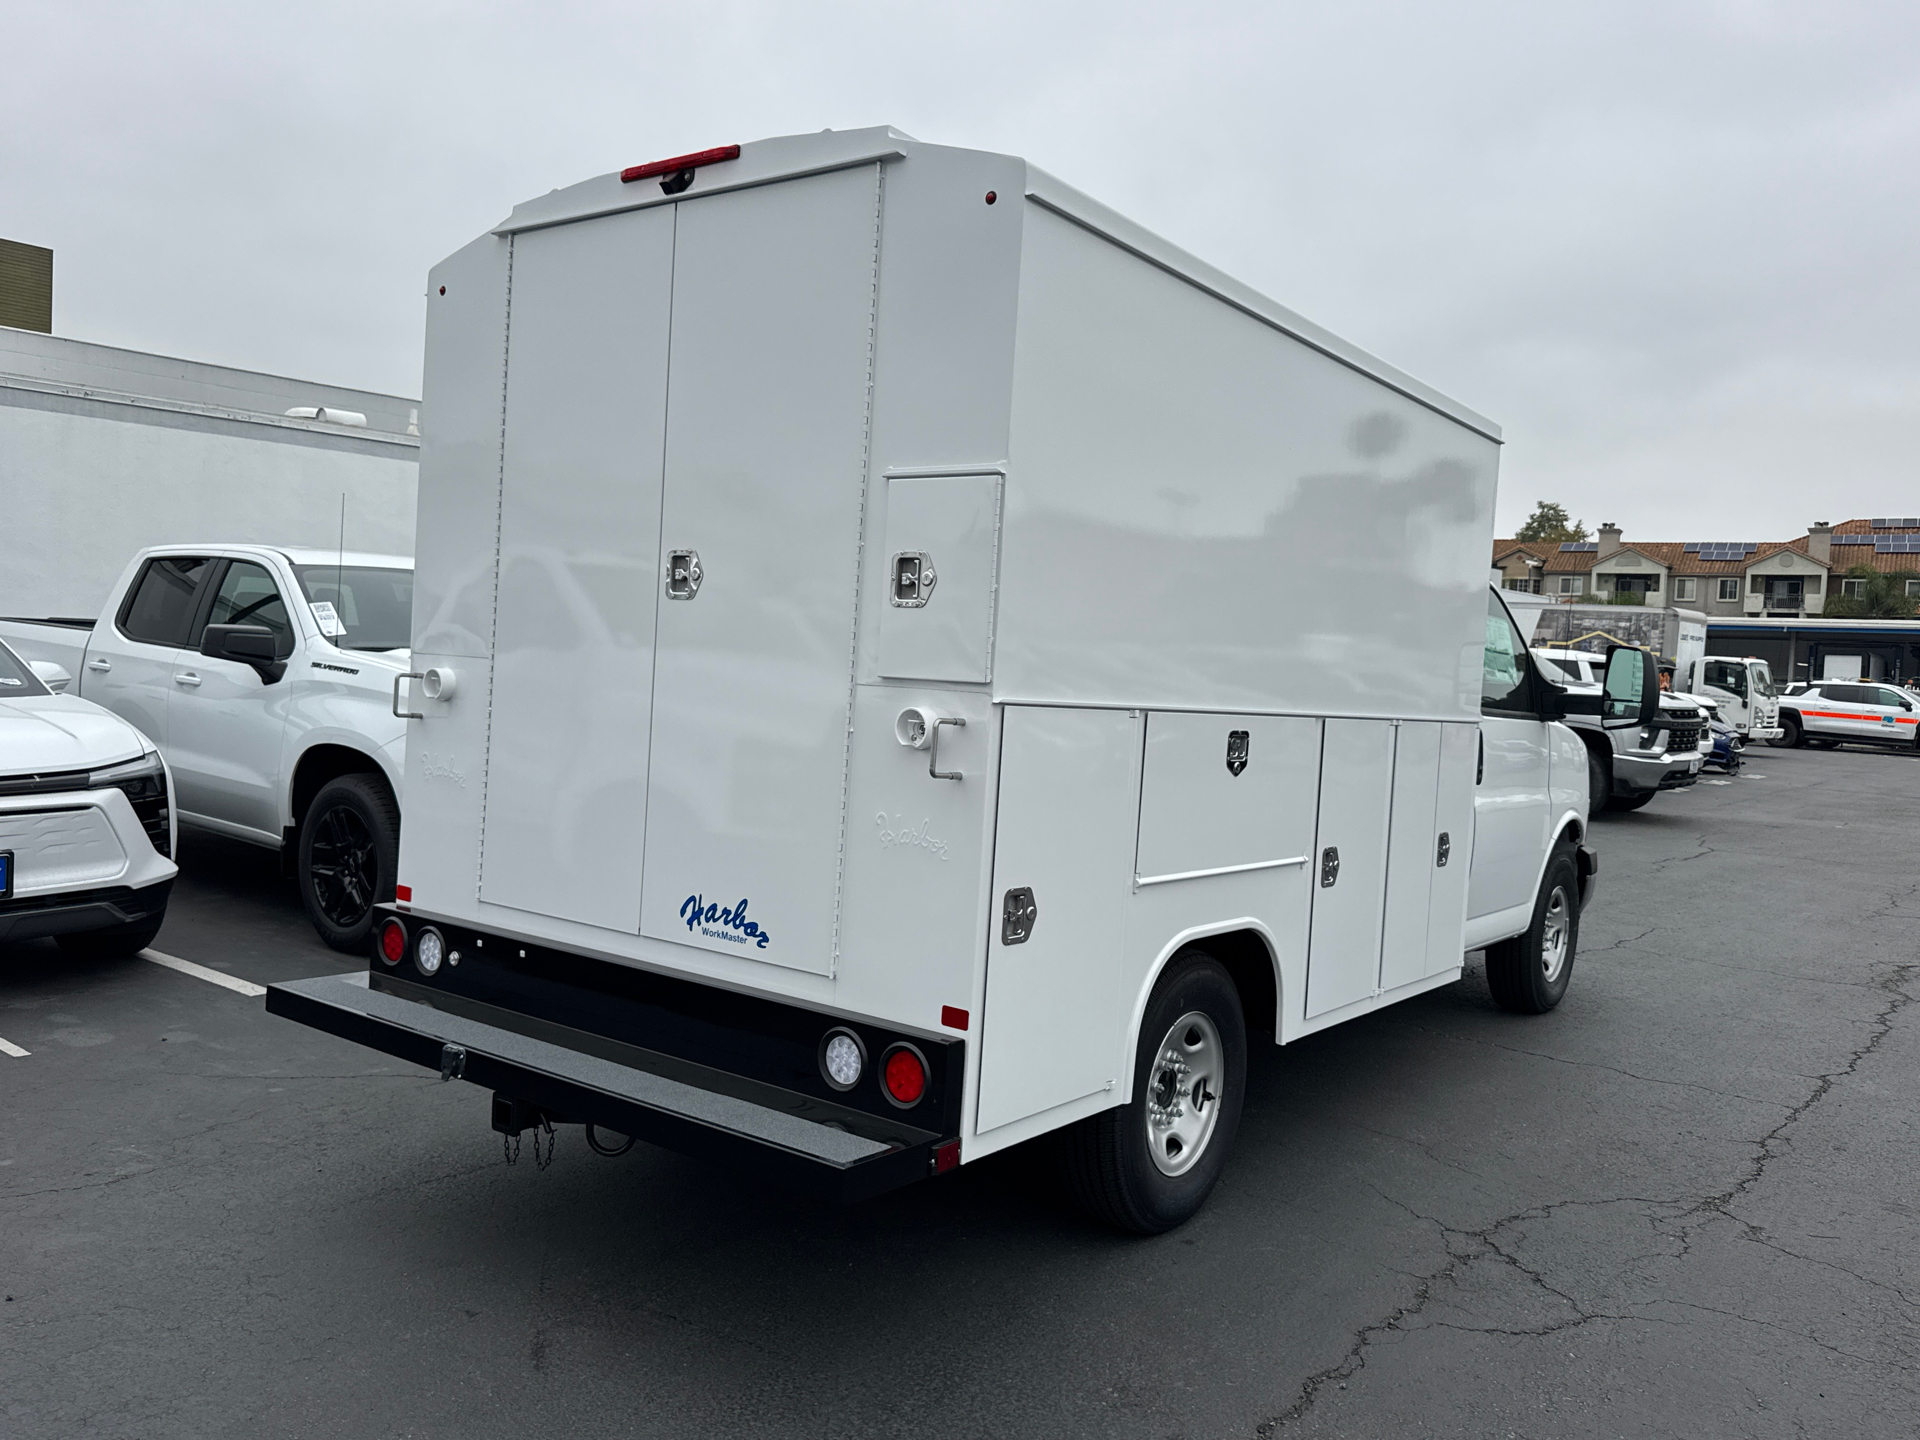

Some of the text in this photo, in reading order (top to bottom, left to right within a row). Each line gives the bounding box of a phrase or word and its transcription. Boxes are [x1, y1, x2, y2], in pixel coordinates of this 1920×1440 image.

[310, 661, 360, 675] SILVERADO
[680, 893, 770, 949] Harbor
[701, 926, 748, 945] WorkMaster
